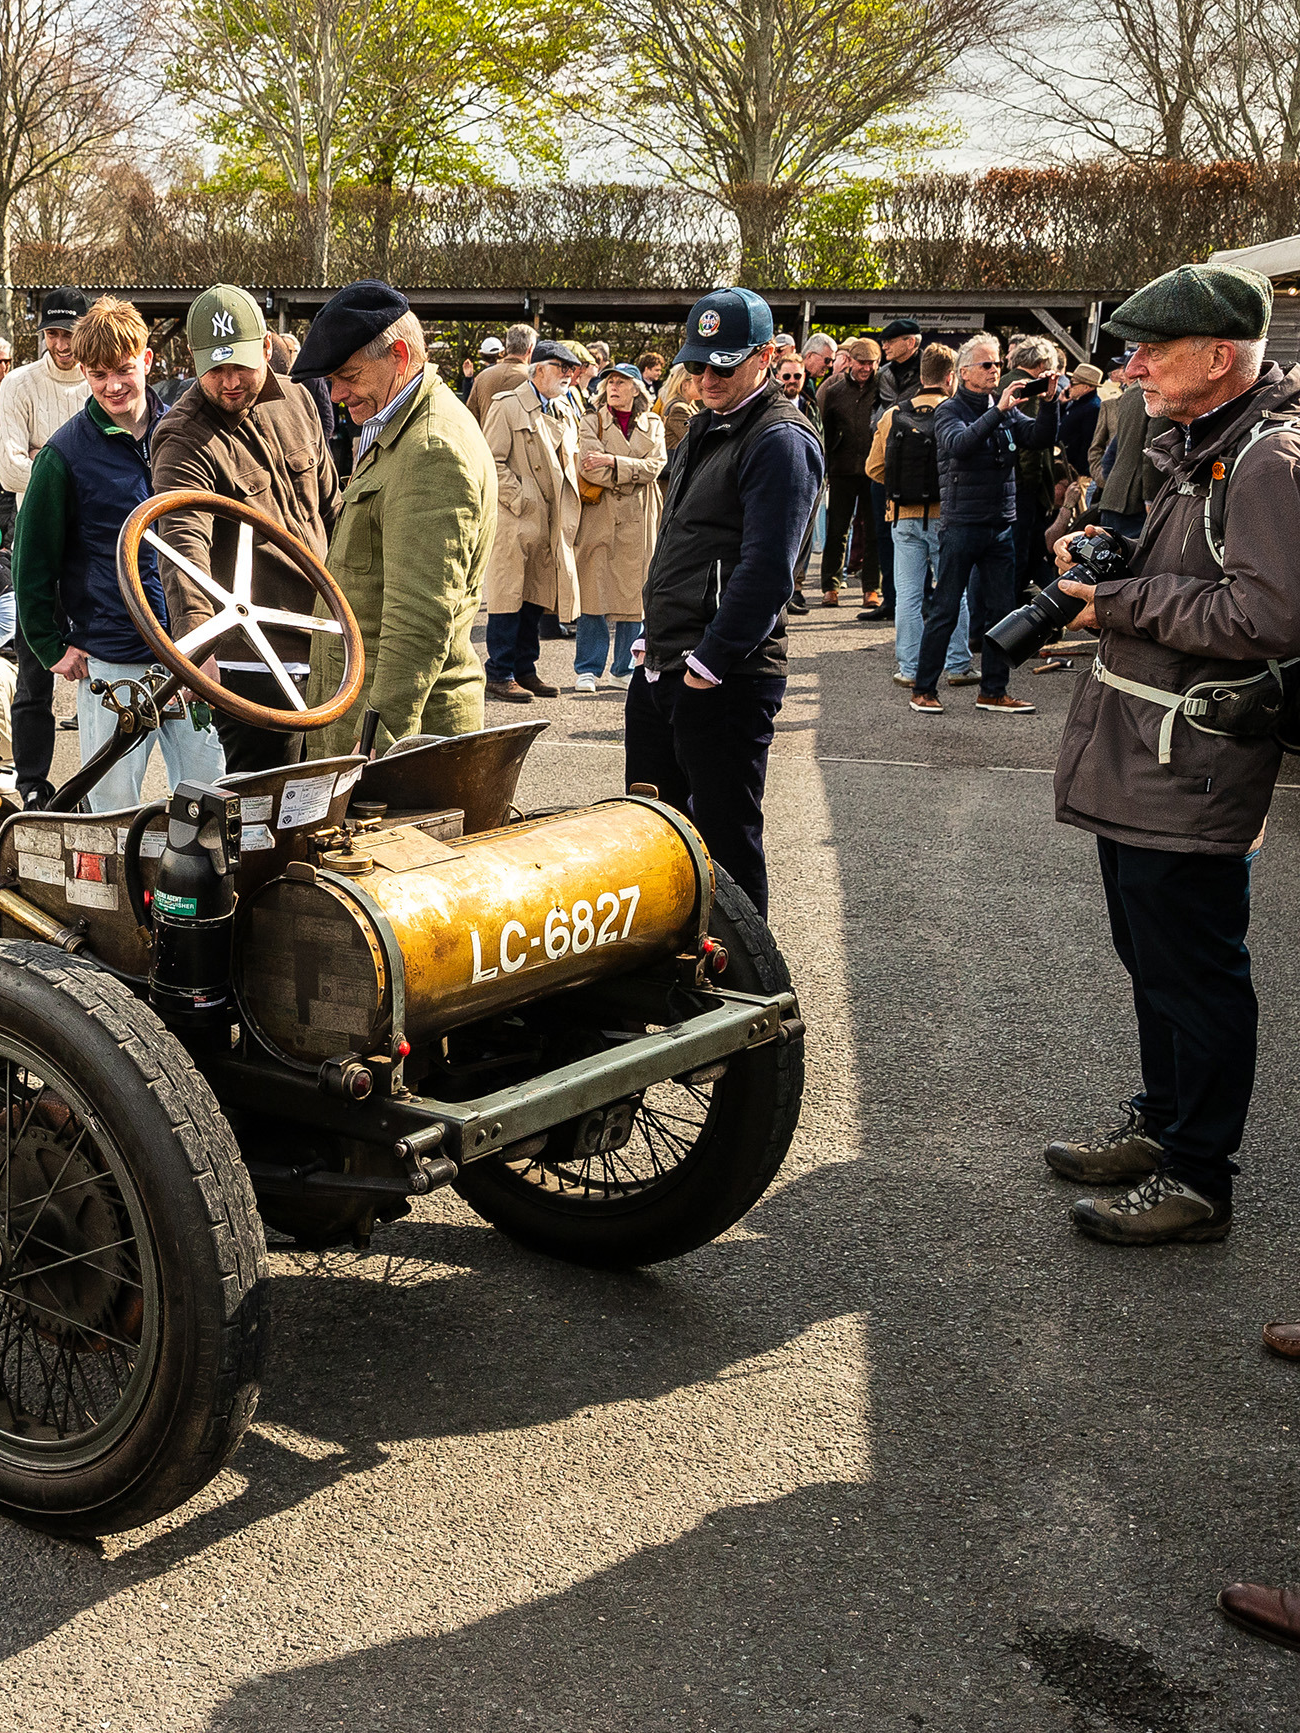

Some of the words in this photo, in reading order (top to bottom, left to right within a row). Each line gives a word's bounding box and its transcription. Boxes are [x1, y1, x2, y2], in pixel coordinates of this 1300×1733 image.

[211, 310, 235, 338] NY
[167, 894, 182, 903] AGENT
[470, 885, 641, 984] LC-6827
[576, 1104, 632, 1154] GB
